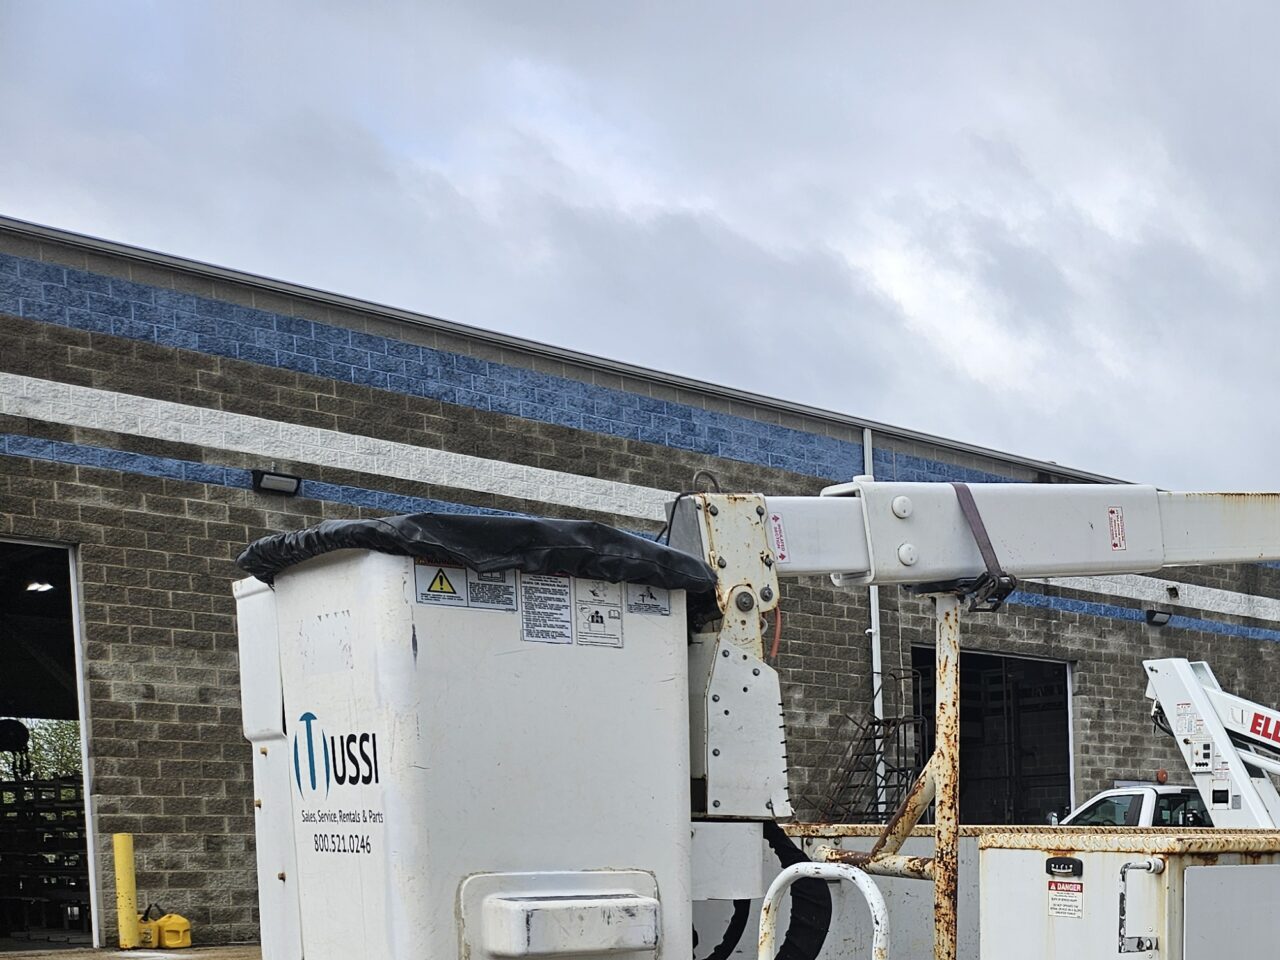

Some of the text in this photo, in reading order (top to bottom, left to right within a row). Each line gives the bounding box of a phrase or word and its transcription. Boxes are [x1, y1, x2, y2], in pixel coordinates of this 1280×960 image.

[330, 733, 379, 786] USSI
[301, 810, 384, 825] Sales, Service, Rentals & Parts
[313, 834, 372, 854] 800.521.0246
[1057, 883, 1081, 891] DANGER
